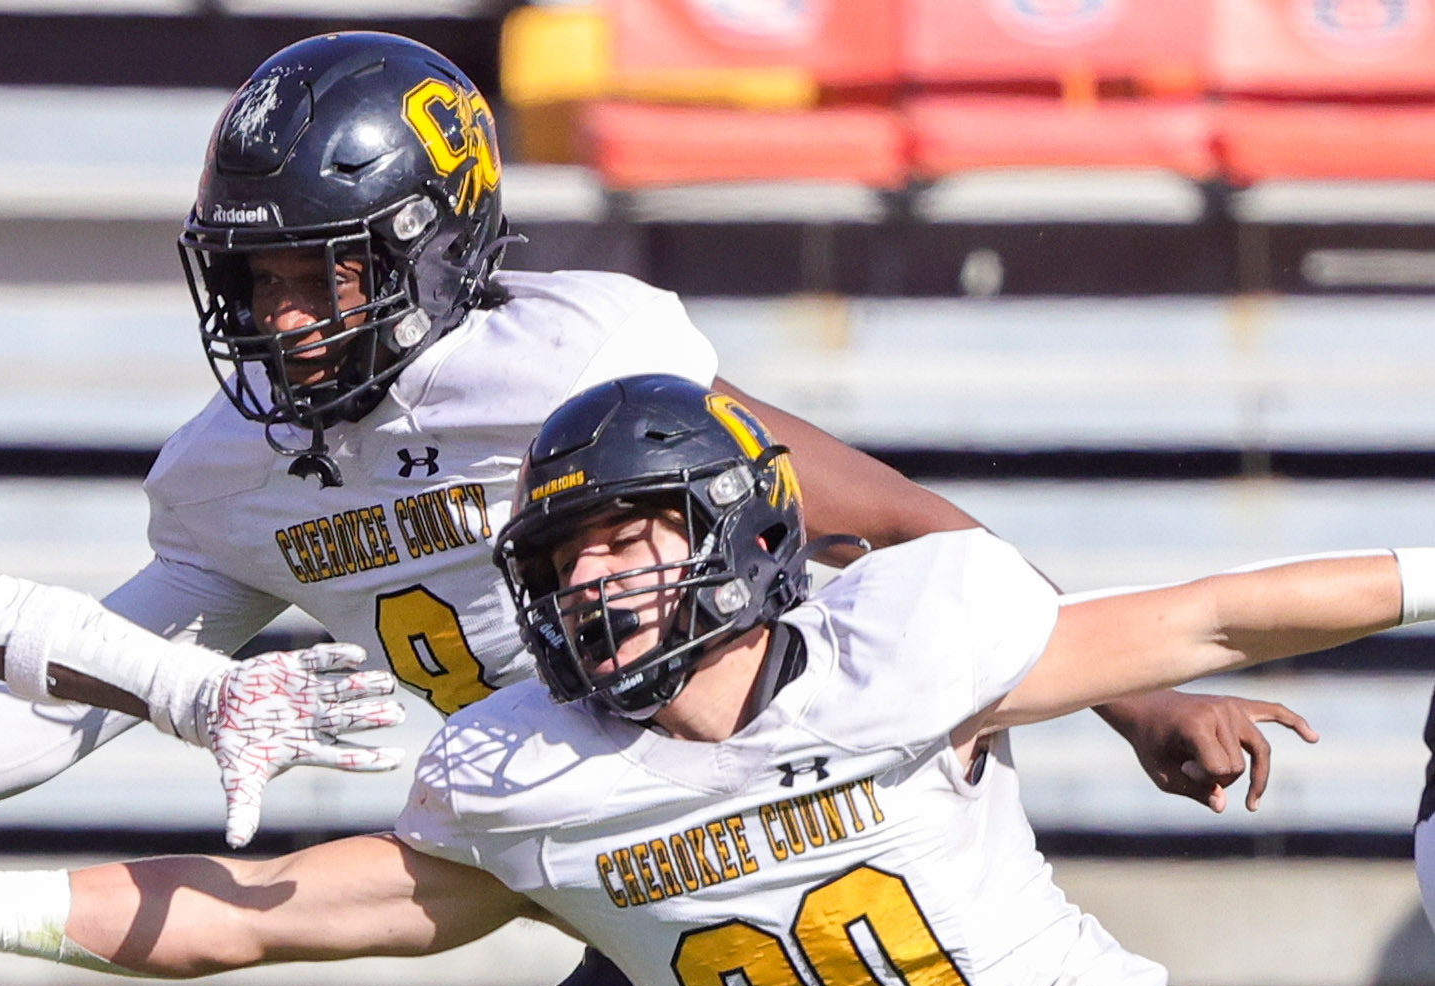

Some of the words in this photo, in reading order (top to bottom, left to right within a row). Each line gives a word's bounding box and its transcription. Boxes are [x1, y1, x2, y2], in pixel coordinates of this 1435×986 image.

[275, 504, 400, 584] CHEROKEE
[394, 484, 492, 559] COUNTY
[531, 470, 584, 501] WARRIORS
[596, 814, 760, 908] CHEROKEE
[758, 776, 885, 861] COUNTY
